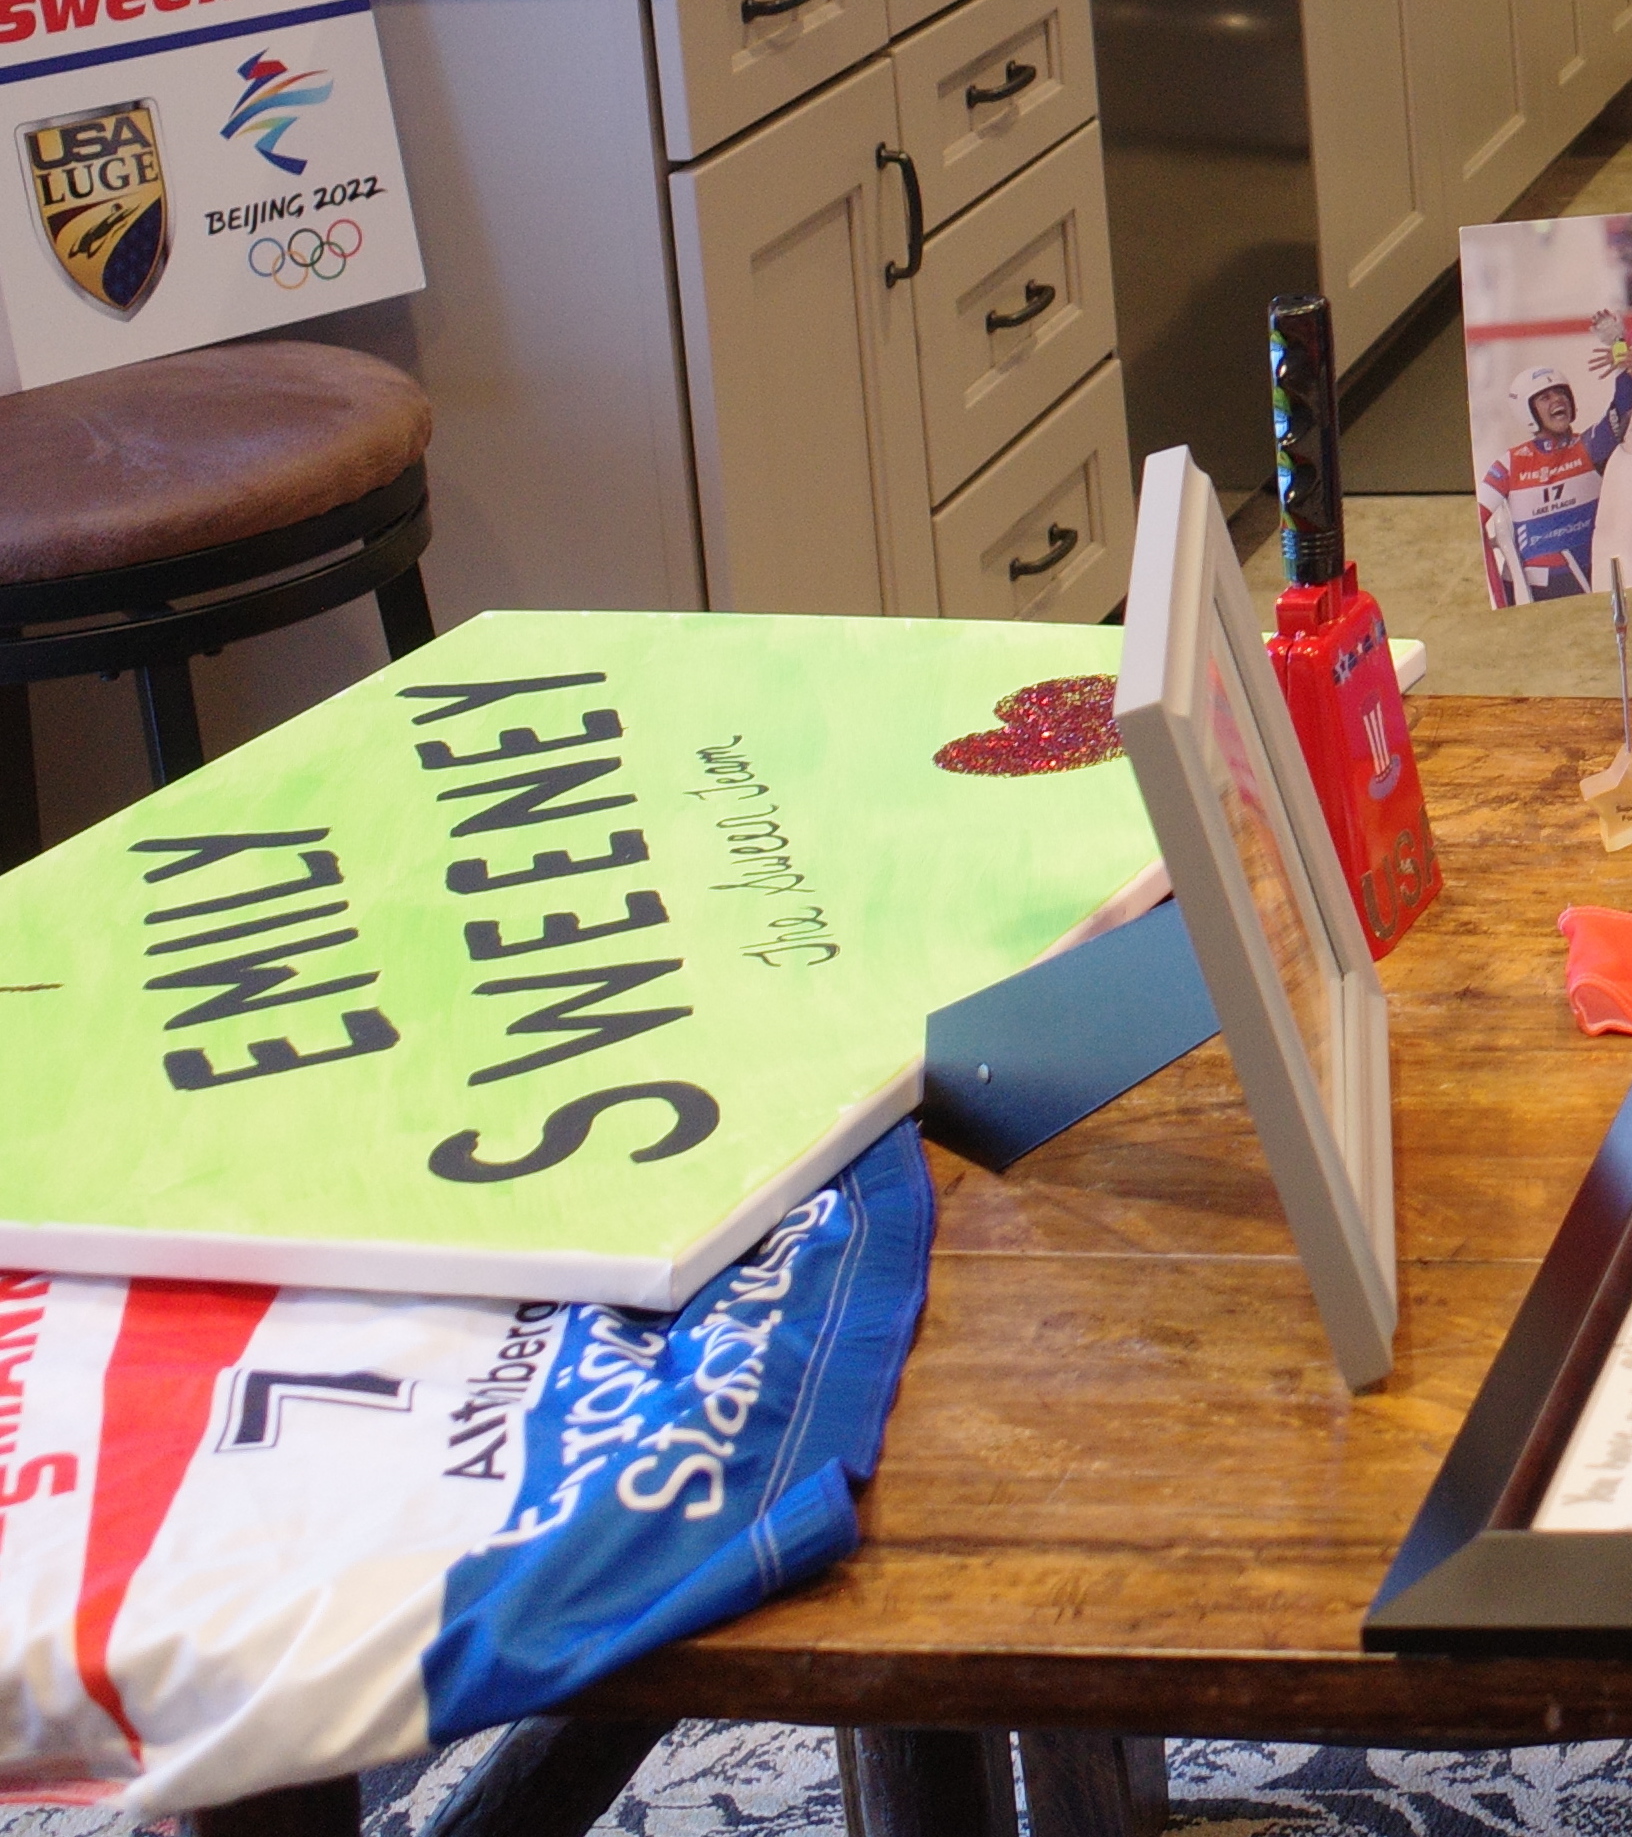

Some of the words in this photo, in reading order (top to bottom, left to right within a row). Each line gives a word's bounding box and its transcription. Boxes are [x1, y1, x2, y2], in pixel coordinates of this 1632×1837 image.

[26, 115, 152, 168] USA
[36, 150, 160, 208] LUGE
[205, 192, 306, 238] BEIJING
[312, 175, 388, 212] 2022
[1542, 482, 1565, 506] 17
[680, 731, 774, 801] Team
[126, 825, 401, 1092] EMILY
[397, 671, 722, 1185] SWEENEY
[738, 904, 843, 969] The
